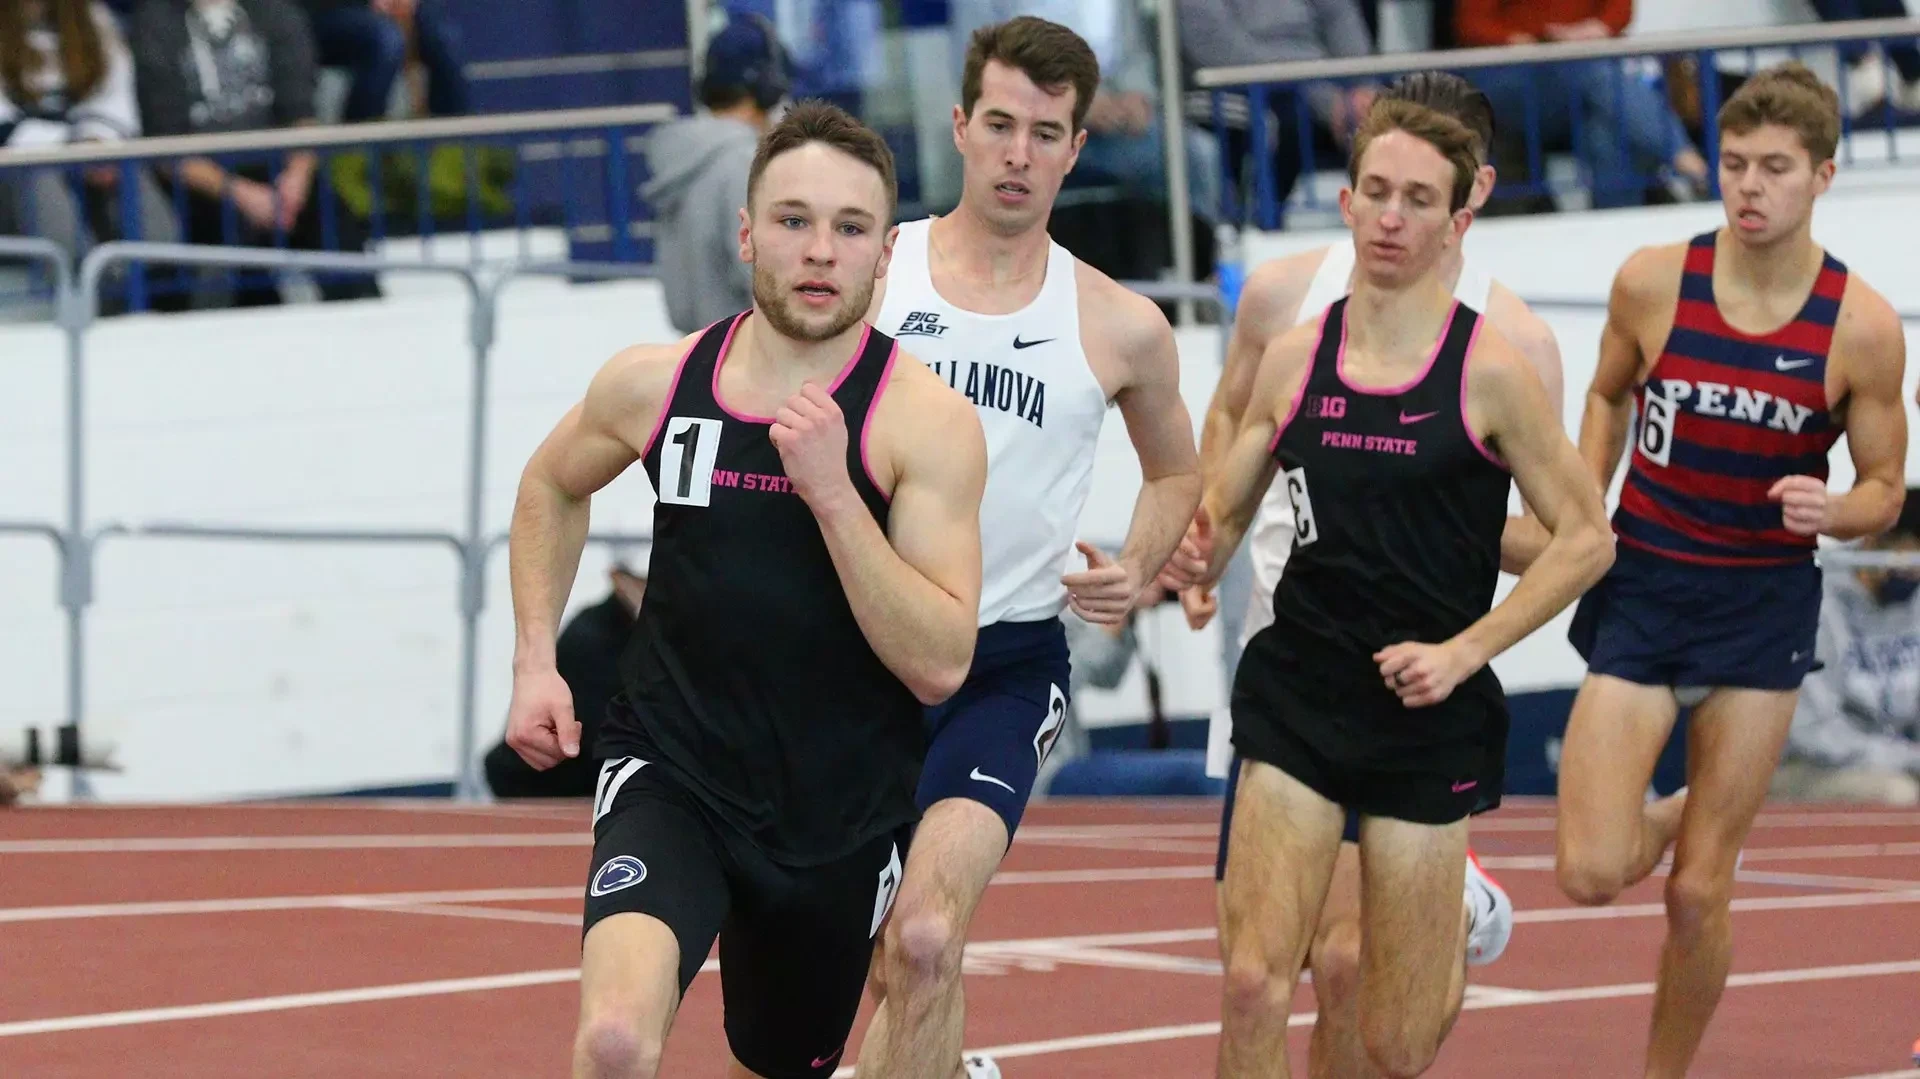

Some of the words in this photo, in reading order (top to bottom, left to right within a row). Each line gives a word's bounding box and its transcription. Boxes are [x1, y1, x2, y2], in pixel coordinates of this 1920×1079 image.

[899, 322, 949, 335] EAST
[907, 311, 940, 323] BIG
[926, 360, 1045, 429] ANOVA
[1661, 379, 1814, 435] PENN
[1321, 431, 1362, 449] PENN
[1365, 435, 1417, 455] STATE
[1644, 401, 1667, 454] 6
[672, 422, 701, 498] 1
[711, 468, 740, 488] NN
